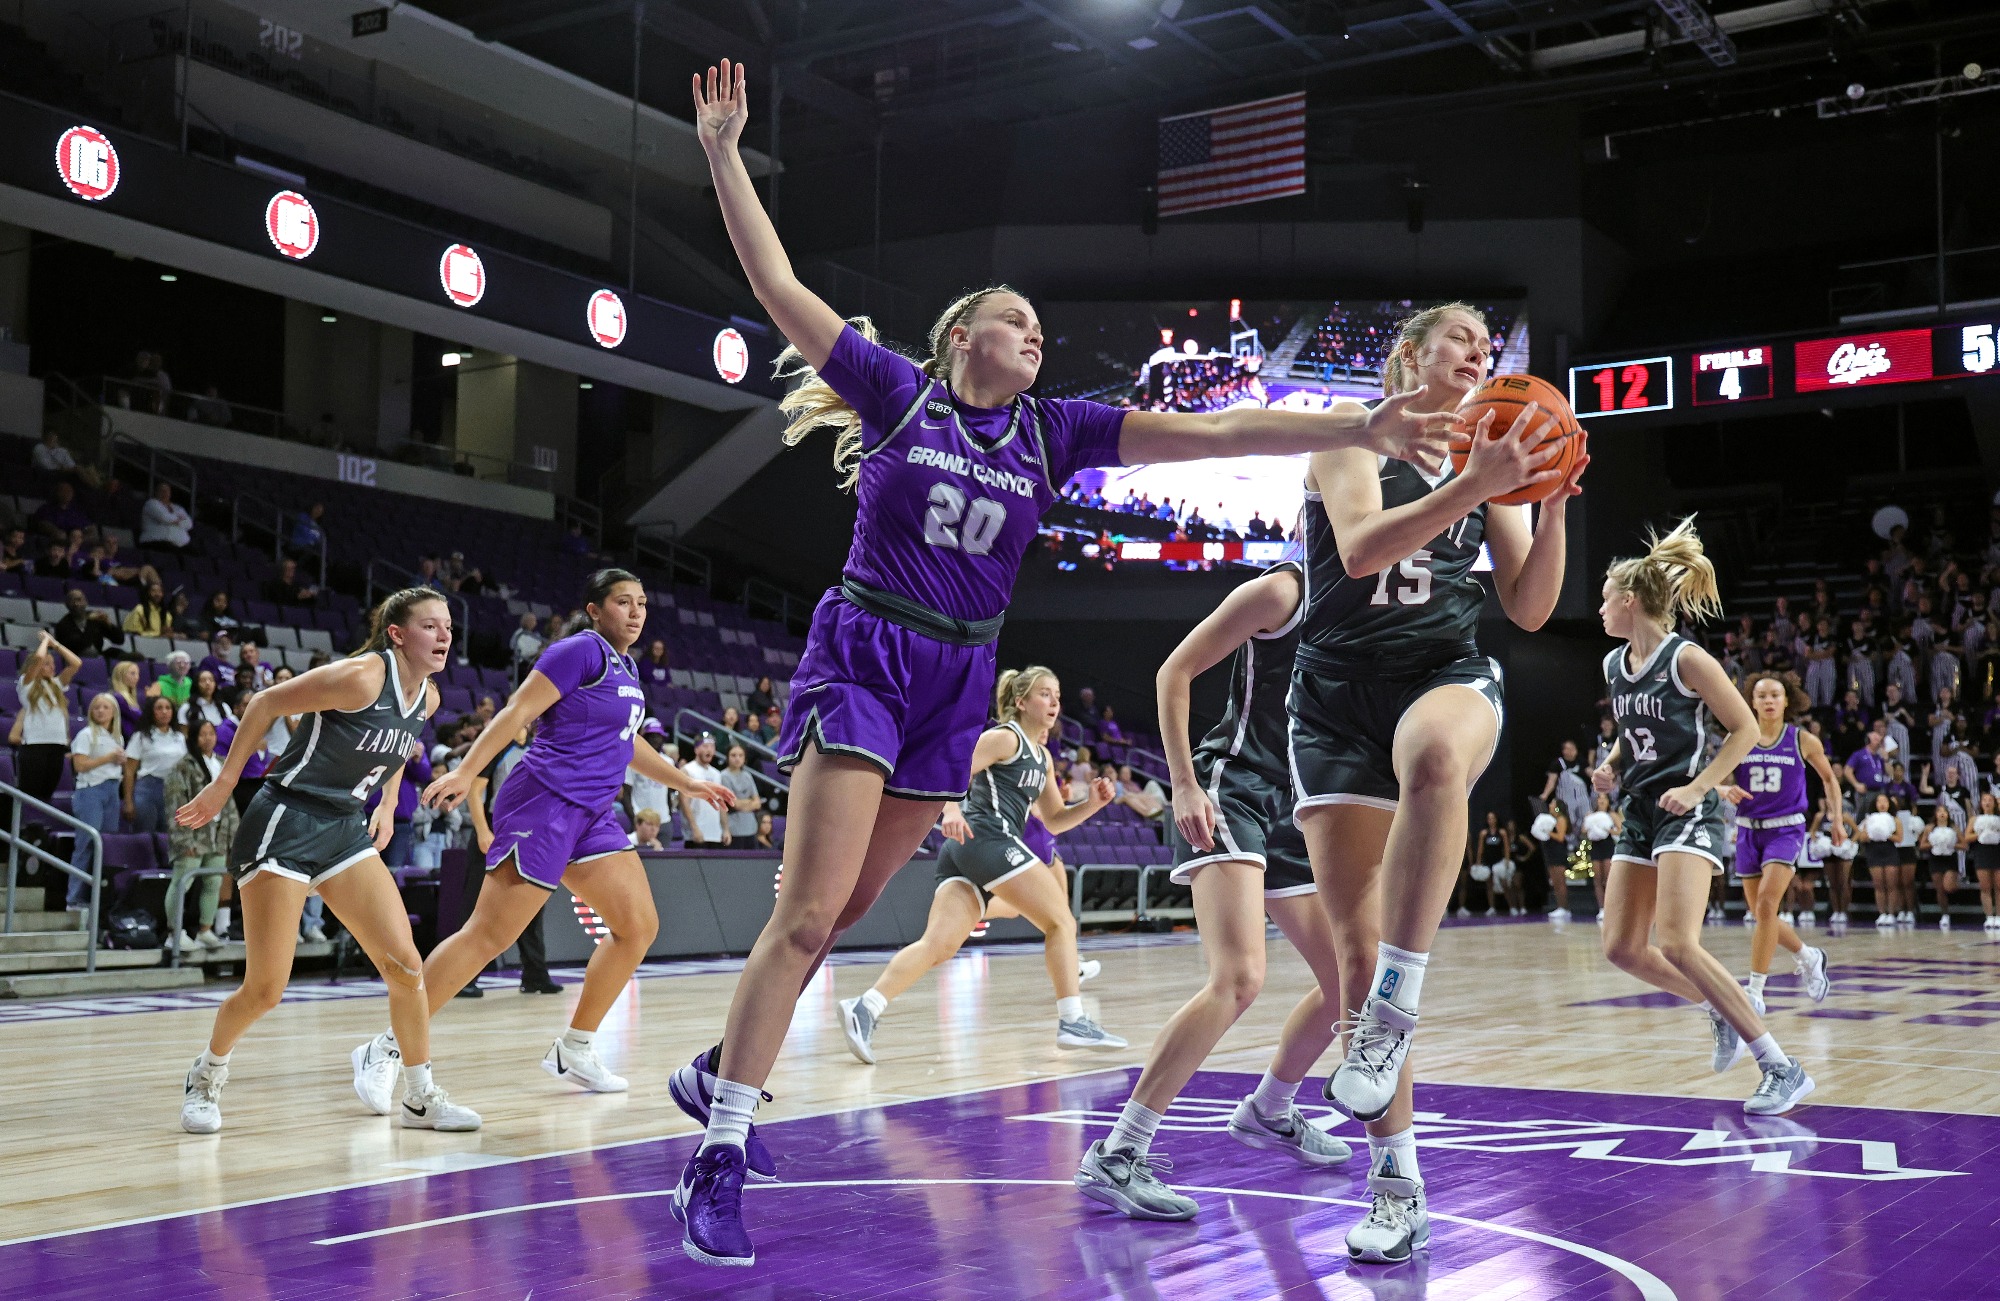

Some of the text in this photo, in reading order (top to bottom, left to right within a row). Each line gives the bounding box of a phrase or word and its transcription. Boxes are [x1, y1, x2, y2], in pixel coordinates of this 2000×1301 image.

[1699, 348, 1763, 371] FOULS
[1962, 324, 2000, 373] 5
[1592, 364, 1649, 411] 12
[1719, 367, 1741, 400] 4
[336, 453, 377, 488] 102
[906, 446, 1038, 498] GRAND CANYON
[924, 481, 1007, 556] 20
[1370, 549, 1433, 606] 15
[1634, 692, 1665, 722] GRIZ
[355, 728, 400, 754] LADY
[1624, 727, 1658, 762] 12
[350, 765, 388, 801] 2
[1748, 765, 1782, 793] 23
